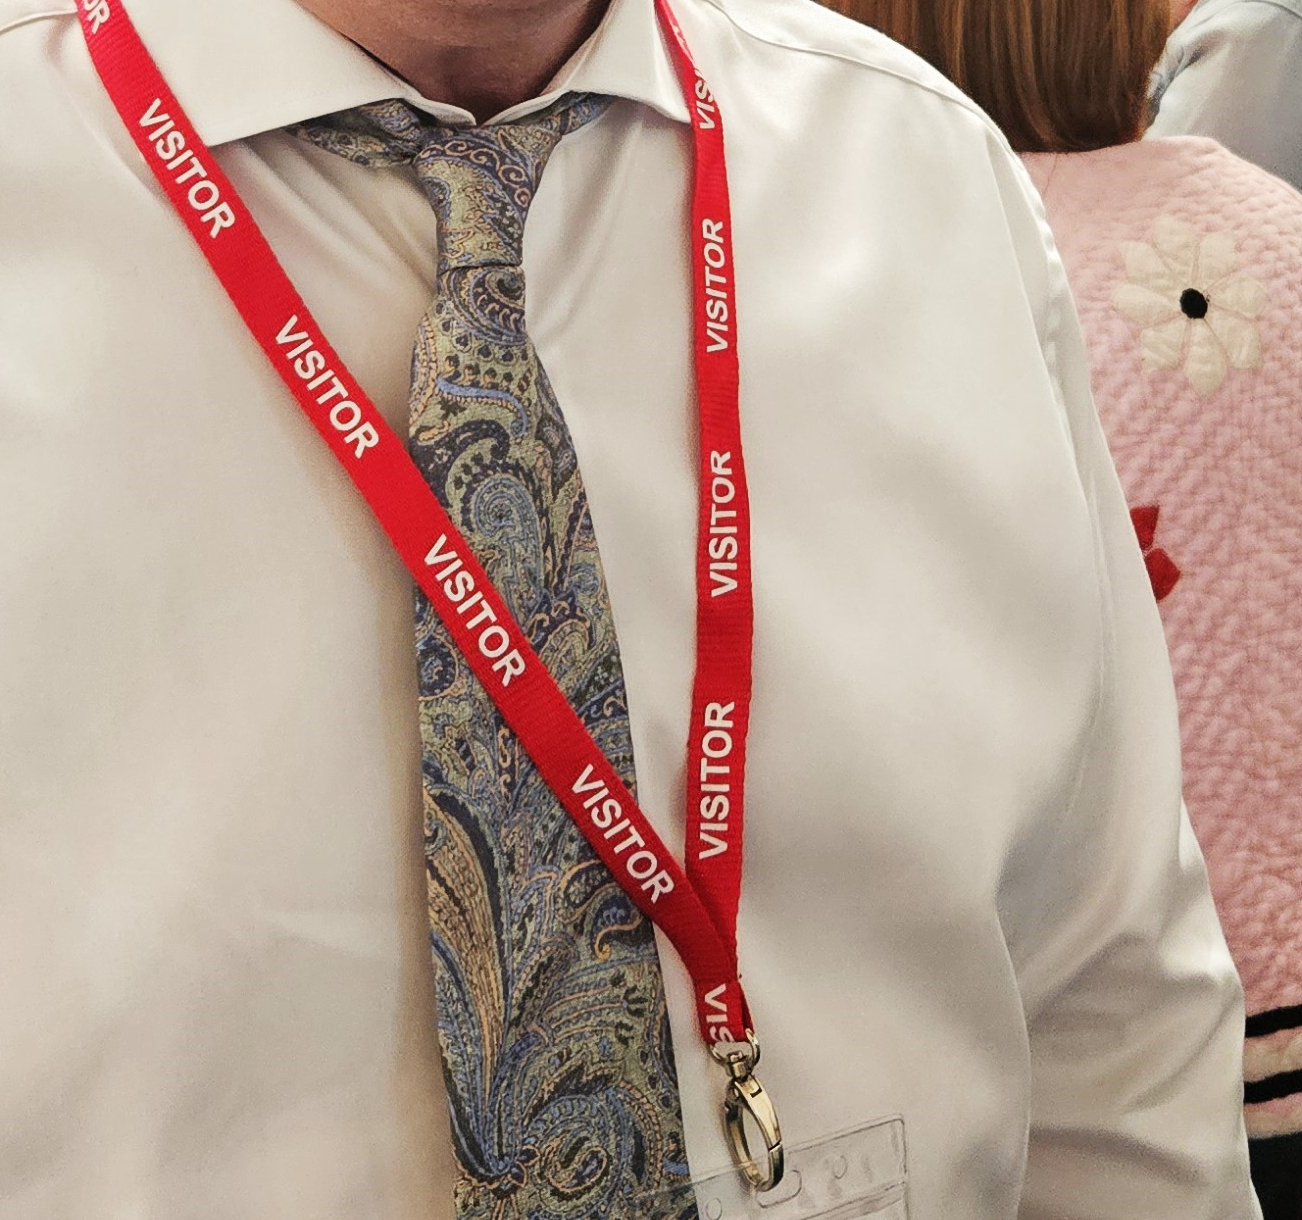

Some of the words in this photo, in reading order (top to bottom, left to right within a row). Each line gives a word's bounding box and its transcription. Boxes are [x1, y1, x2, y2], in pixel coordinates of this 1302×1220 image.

[139, 98, 236, 238] VISITOR
[702, 218, 729, 354] VISITOR
[275, 315, 379, 459] VISITOR
[709, 449, 739, 598] VISITOR
[424, 534, 526, 686] VISITOR
[571, 763, 675, 904] VISITOR
[698, 700, 735, 860] VISITOR
